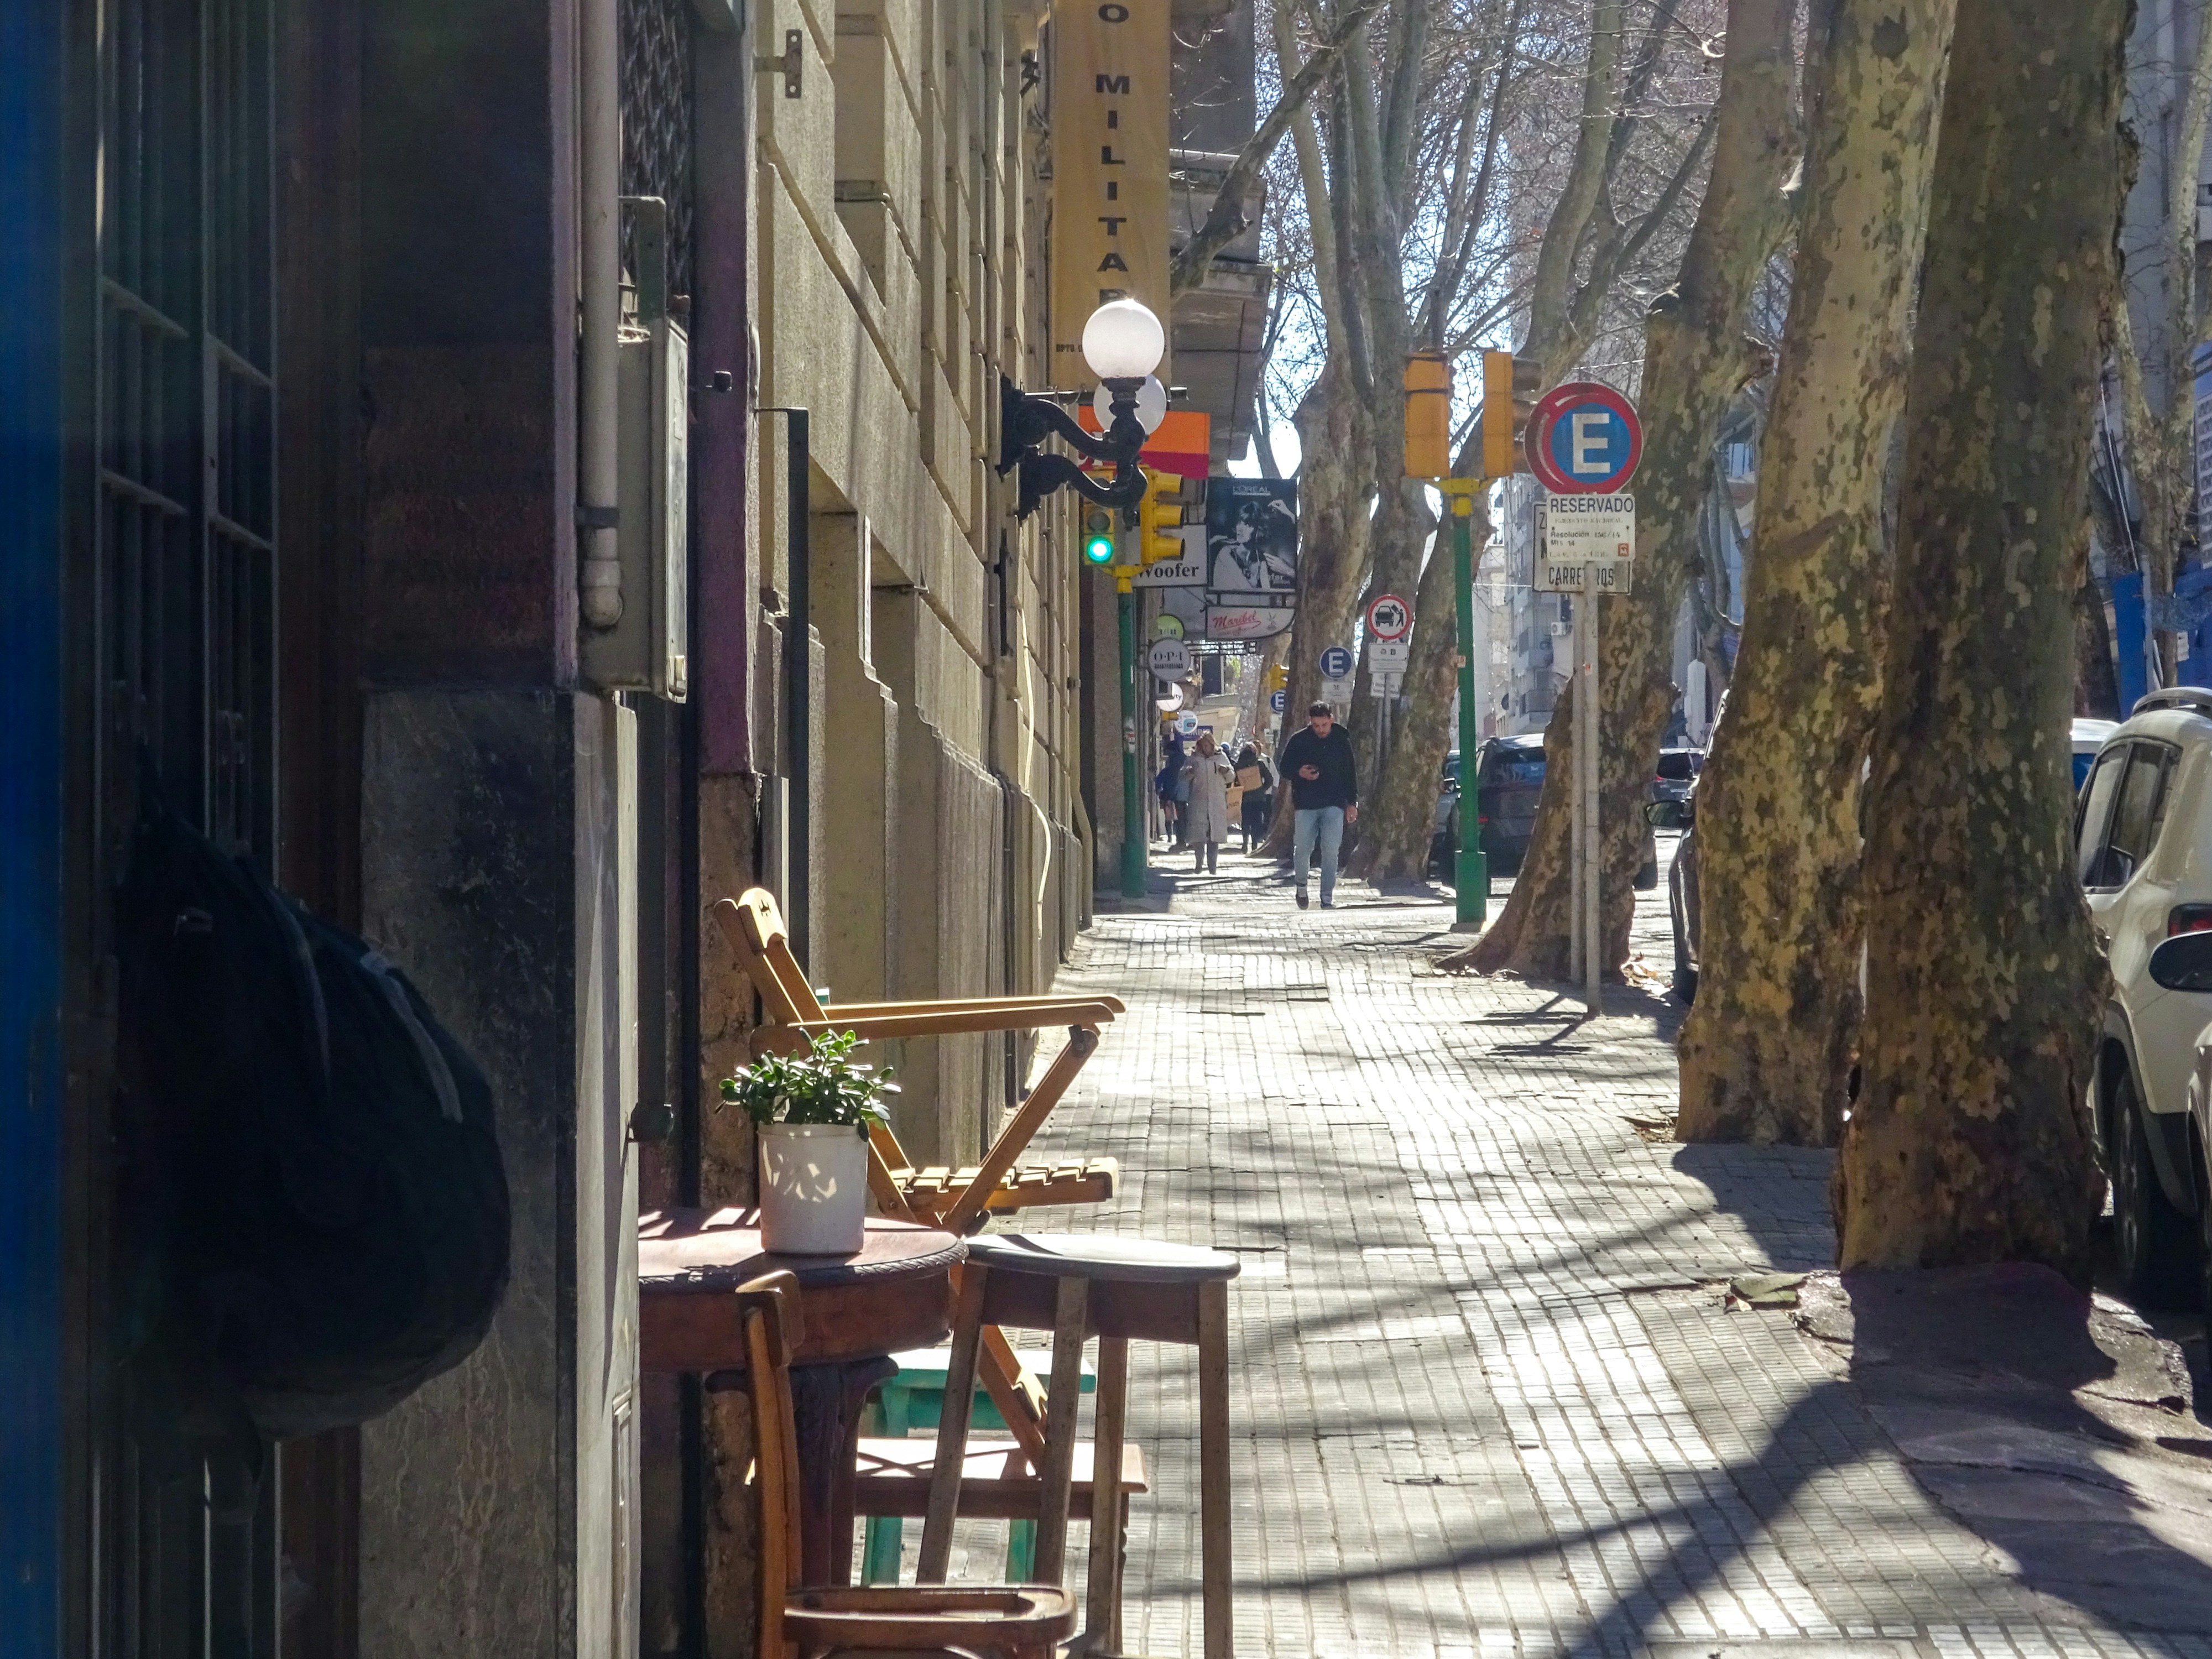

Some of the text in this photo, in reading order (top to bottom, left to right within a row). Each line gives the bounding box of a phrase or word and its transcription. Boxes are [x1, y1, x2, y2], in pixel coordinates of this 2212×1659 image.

[1572, 413, 1610, 474] E
[1551, 498, 1634, 513] RESERVADO
[1549, 566, 1614, 586] CARREOS
[1212, 610, 1257, 629] Maribel
[1328, 652, 1344, 673] E
[1275, 693, 1285, 708] E
